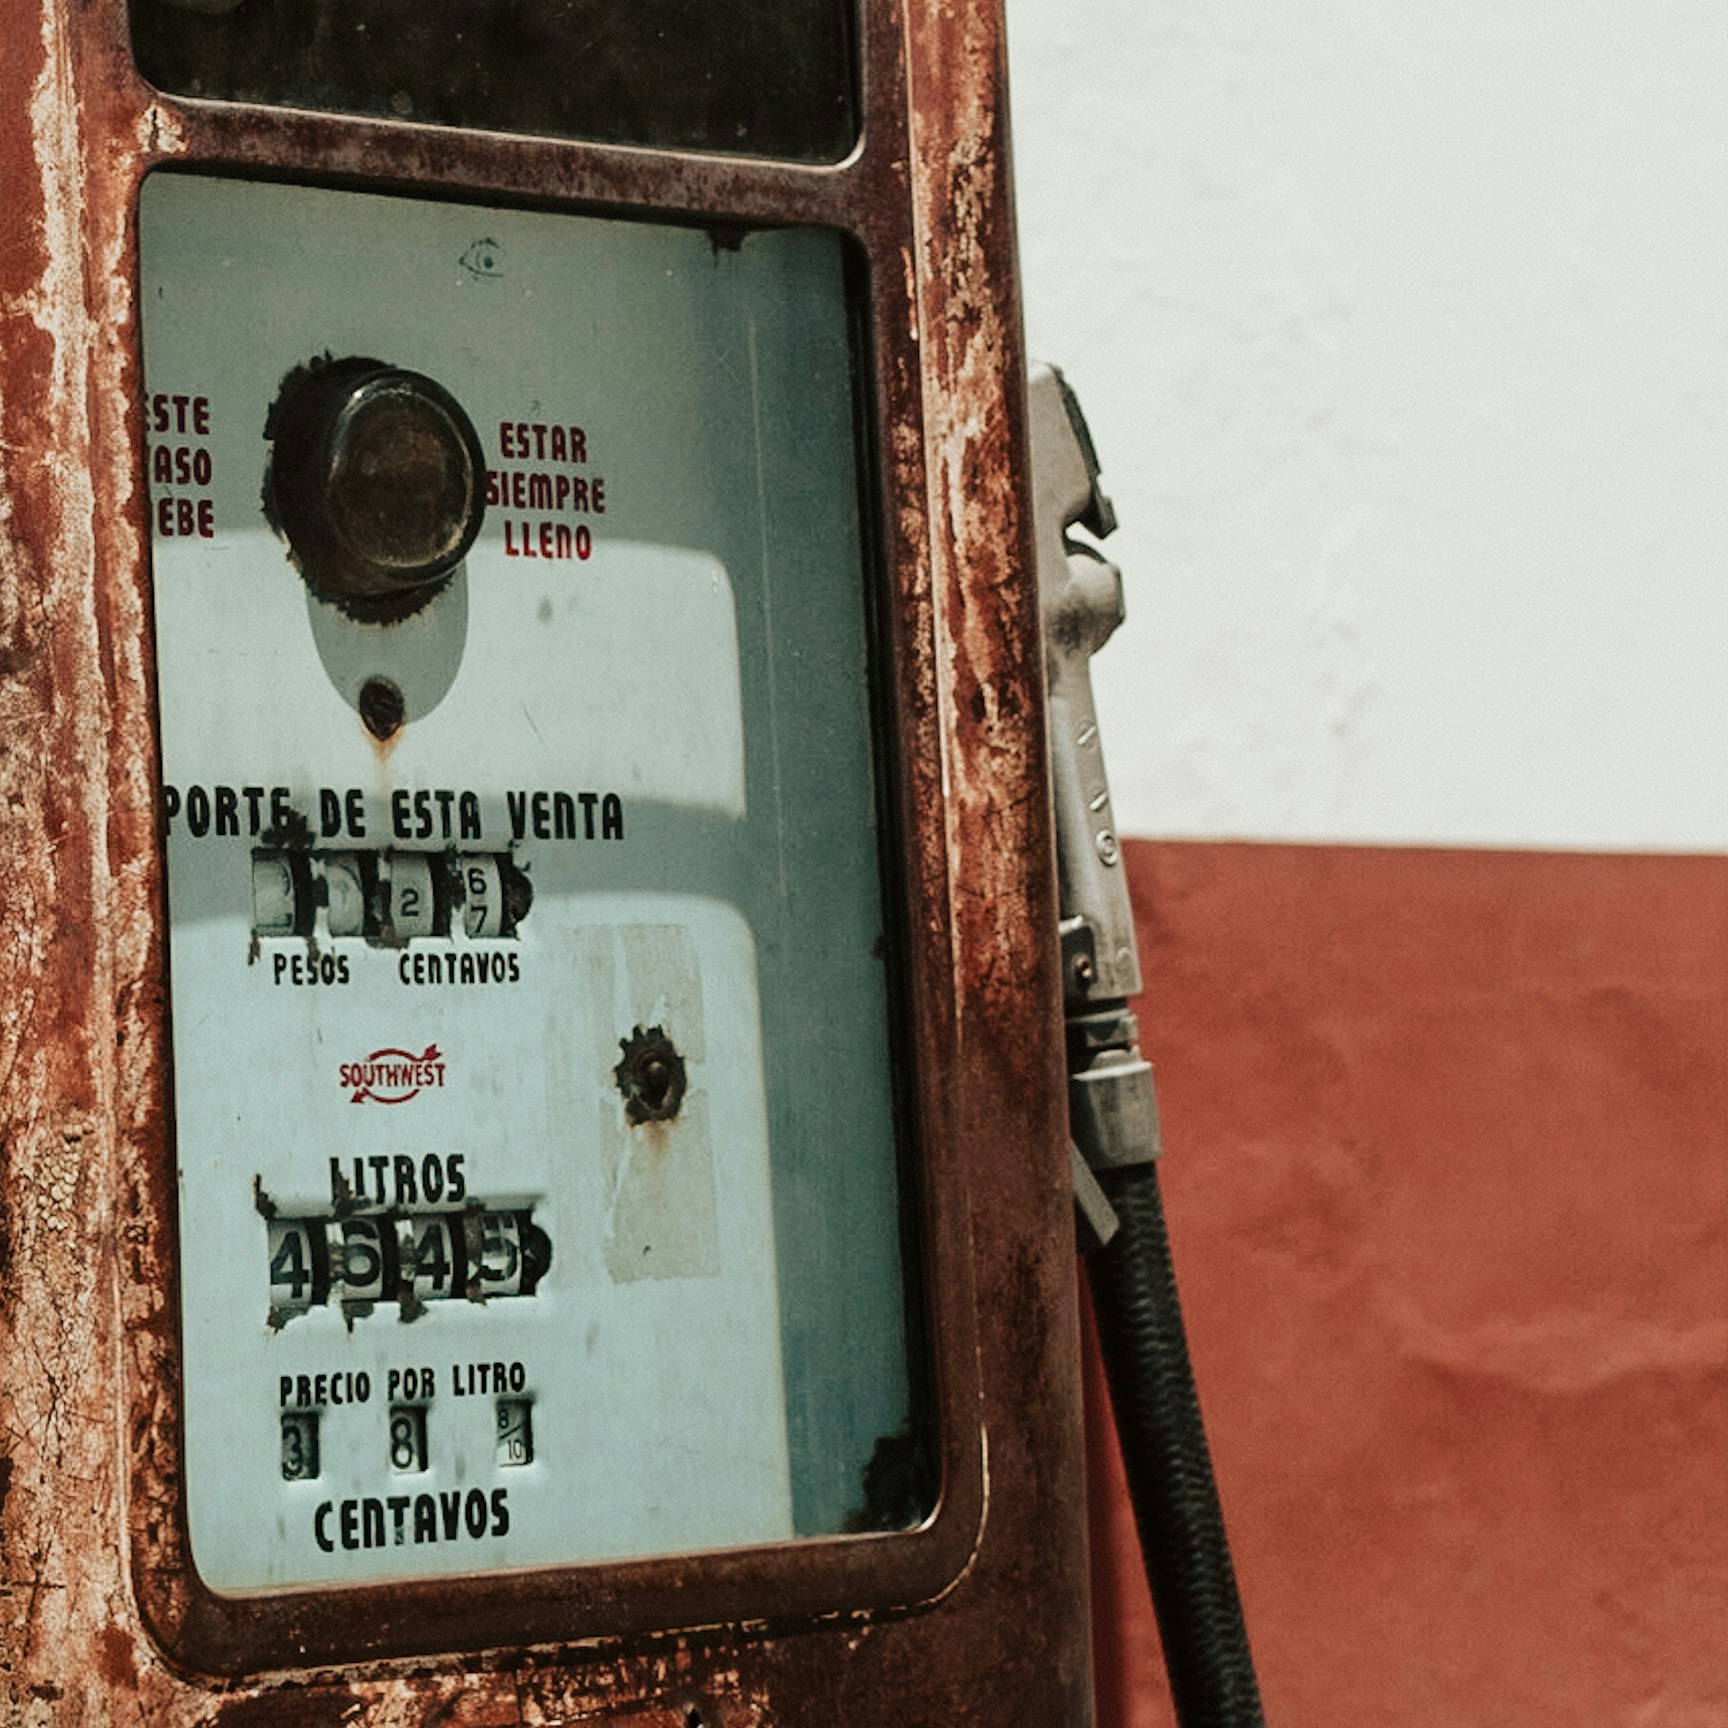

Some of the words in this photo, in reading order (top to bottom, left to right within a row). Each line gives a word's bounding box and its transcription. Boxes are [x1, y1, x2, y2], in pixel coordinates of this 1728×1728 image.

[500, 422, 587, 463] ESTAR
[153, 445, 212, 486] ASO
[486, 470, 605, 513] SIEMPRE
[158, 497, 214, 538] EBE
[504, 520, 591, 561] LLENO
[161, 784, 293, 839] PORTE
[319, 788, 366, 838] DE
[391, 789, 482, 840] ESTA
[506, 791, 625, 841] VENTA
[273, 953, 349, 985] PESOS
[399, 952, 520, 985] CENTAVOS
[339, 1062, 446, 1088] SOUTHWEST
[329, 1153, 465, 1205] LITROS
[280, 1372, 371, 1408] PRECIO
[388, 1368, 435, 1401] POR
[452, 1361, 526, 1397] LITRO
[314, 1487, 510, 1553] CENTAVOS
